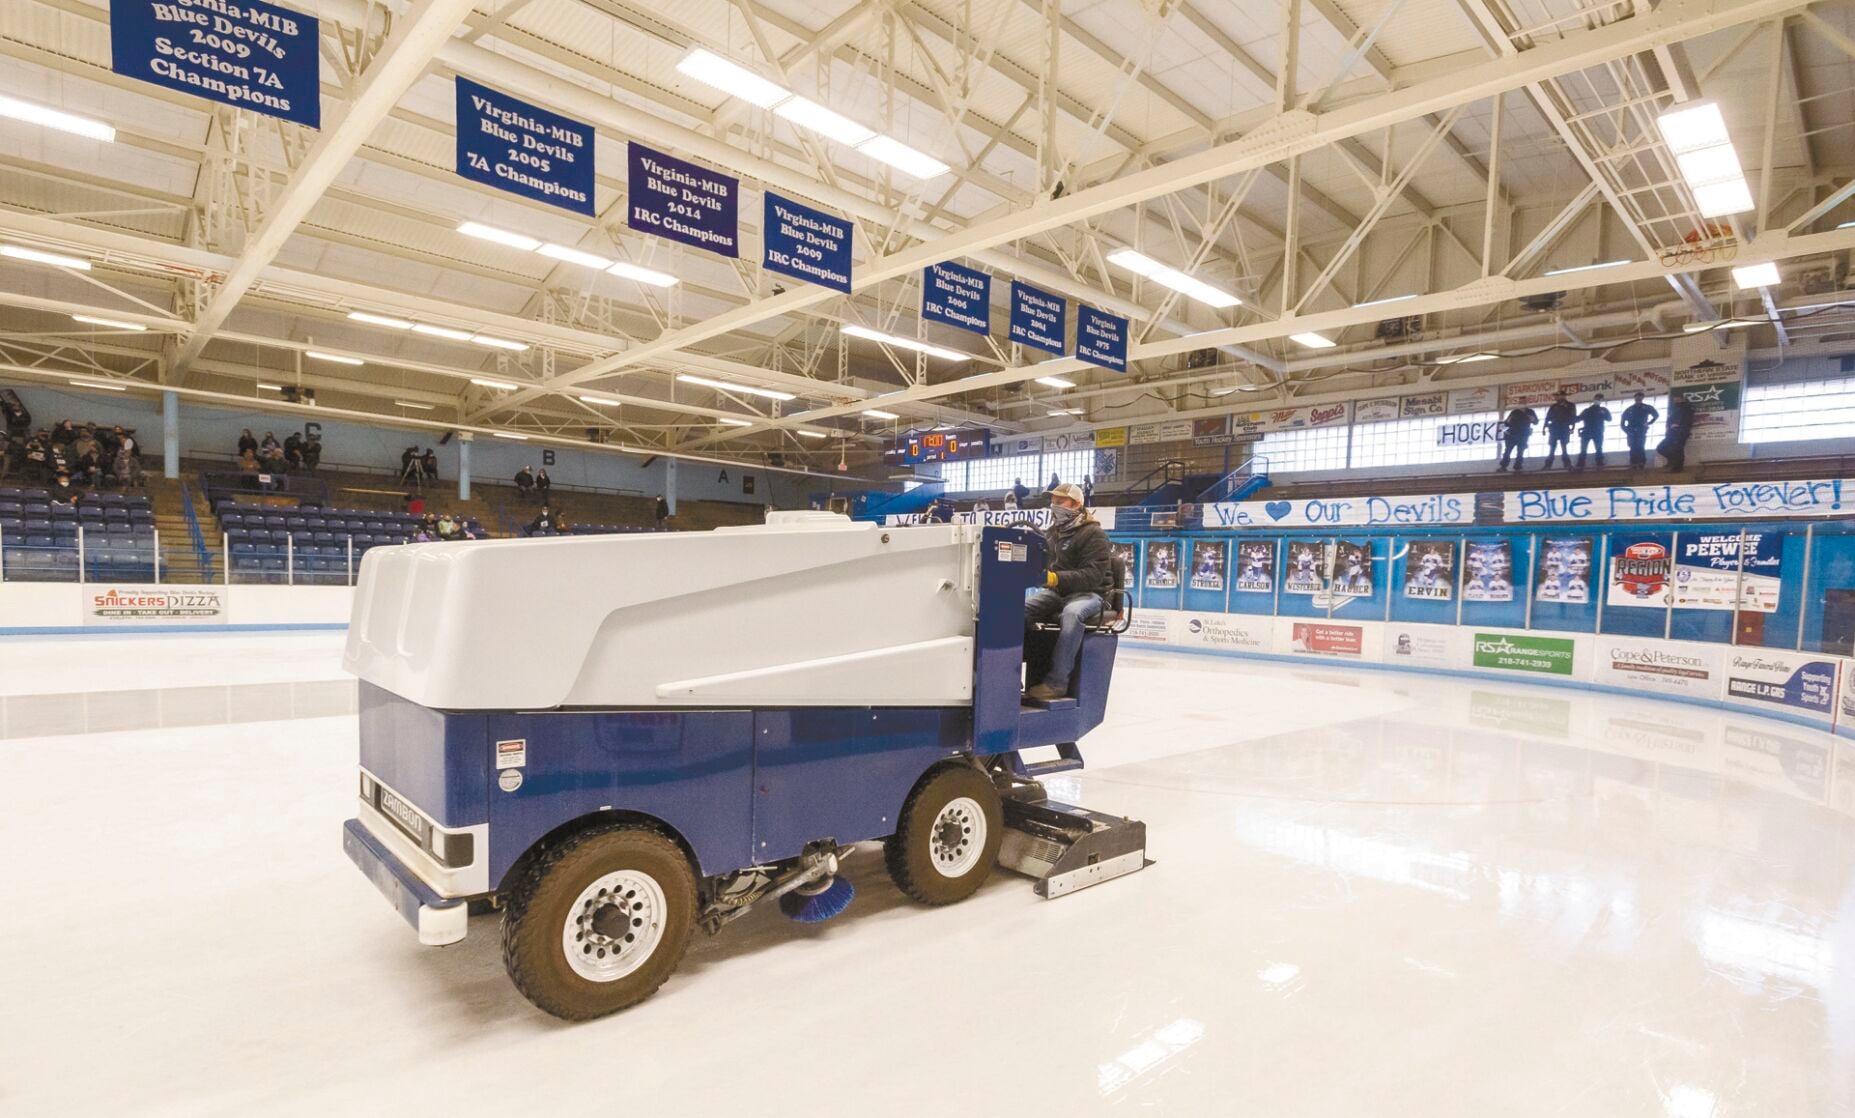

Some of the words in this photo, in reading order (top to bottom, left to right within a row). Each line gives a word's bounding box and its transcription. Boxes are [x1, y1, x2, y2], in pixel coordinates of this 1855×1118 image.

[152, 3, 209, 26] Blue
[214, 16, 286, 59] Devils
[190, 29, 251, 58] 2009
[155, 37, 250, 80] Section
[253, 66, 285, 90] 7A
[150, 58, 291, 111] Champions
[472, 96, 584, 148] Virginia-MIB
[481, 119, 518, 143] Blue
[524, 134, 574, 163] Devils
[508, 149, 550, 173] 2005
[467, 152, 491, 172] 7A
[496, 164, 587, 203] Champions
[640, 157, 728, 197] Virginia-MIB
[647, 177, 678, 197] Blue
[682, 189, 722, 212] Devils
[668, 202, 701, 220] 2014
[634, 207, 661, 225] IRC
[664, 217, 733, 248] Champions
[775, 206, 845, 240] Virginia-MIB
[781, 224, 805, 241] Blue
[806, 233, 838, 252] Devils
[797, 245, 823, 261] 2009
[769, 250, 790, 266] IRC
[792, 258, 848, 285] Champions
[932, 264, 985, 290] Virginia-MIB
[936, 278, 955, 294] Blue
[956, 285, 981, 301] Devils
[1018, 290, 1061, 313] Virginia-MIB
[926, 301, 943, 315] IRC
[945, 308, 987, 329] Champions
[1021, 303, 1036, 316] Blue
[1036, 309, 1057, 324] Devils
[1091, 315, 1117, 330] Virginia
[1013, 324, 1027, 337] IRC
[1028, 331, 1062, 349] Champions
[1086, 325, 1101, 337] Blue
[1101, 330, 1120, 343] Devils
[1080, 345, 1092, 356] IRC
[1092, 349, 1124, 366] Champions
[306, 423, 322, 441] C
[1442, 421, 1506, 444] HOCKE
[950, 440, 957, 453] 0
[543, 449, 556, 466] B
[718, 470, 729, 484] A
[1517, 490, 1593, 520] Blue
[1606, 486, 1696, 519] Pride
[1712, 480, 1843, 510] Forever!
[1214, 503, 1254, 526] We
[1305, 500, 1353, 524] Our
[1366, 496, 1462, 525] Devils
[1686, 542, 1759, 557] PEEWEE
[1700, 535, 1763, 544] WELCOME
[1618, 559, 1671, 576] REGION
[1711, 557, 1742, 570] Player
[1408, 586, 1448, 597] ERVIN
[167, 596, 221, 609] PIZZA
[1203, 626, 1249, 638] Orthopedics
[1211, 637, 1230, 645] Sports
[1231, 638, 1261, 646] Medicine
[1610, 648, 1641, 662] Cope
[1641, 648, 1653, 664] &
[1654, 651, 1702, 667] Peterson
[1801, 671, 1832, 685] Supporting
[1803, 682, 1819, 692] Youth
[1730, 681, 1756, 694] RANGE
[1770, 686, 1786, 699] GAS
[1801, 692, 1820, 704] Sports
